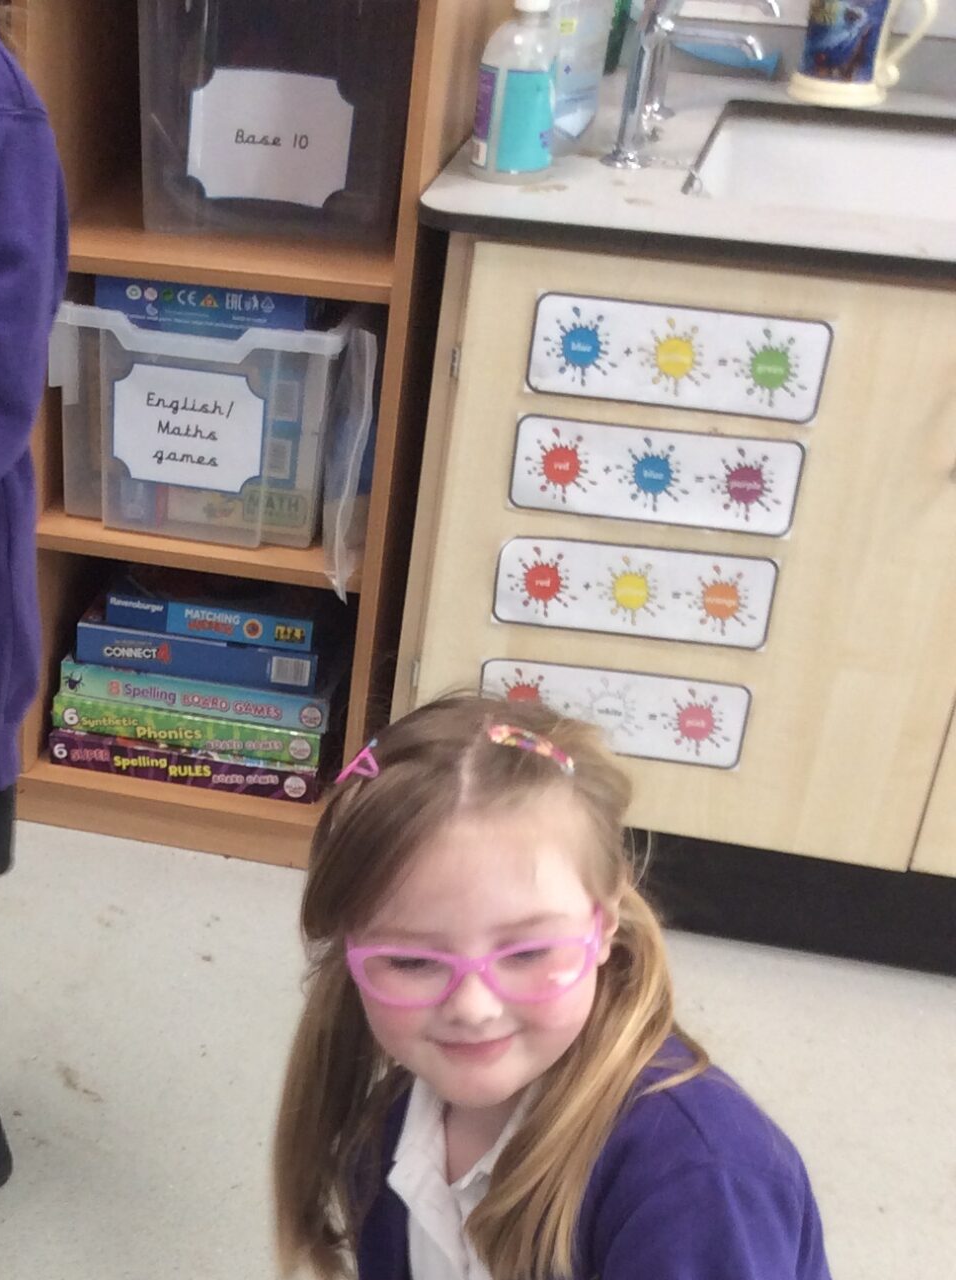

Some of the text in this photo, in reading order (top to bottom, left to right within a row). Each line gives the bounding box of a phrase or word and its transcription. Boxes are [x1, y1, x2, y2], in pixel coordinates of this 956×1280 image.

[234, 129, 310, 150] Base 10
[145, 391, 235, 419] English/
[156, 420, 219, 443] Maths
[152, 447, 220, 469] games
[552, 460, 571, 472] red
[534, 577, 551, 588] red
[109, 596, 164, 613] Ravensburger
[184, 608, 241, 626] MATCHING
[103, 645, 158, 660] CONNECT
[107, 679, 121, 698] 8
[124, 683, 177, 705] Spelling
[181, 693, 230, 712] BOARD
[233, 700, 283, 721] GAMES
[62, 707, 80, 726] 6
[81, 716, 139, 728] Synthetic
[136, 726, 202, 741] Phonics
[52, 742, 69, 760] 6
[113, 755, 169, 770] Spelling
[168, 763, 213, 778] RULES
